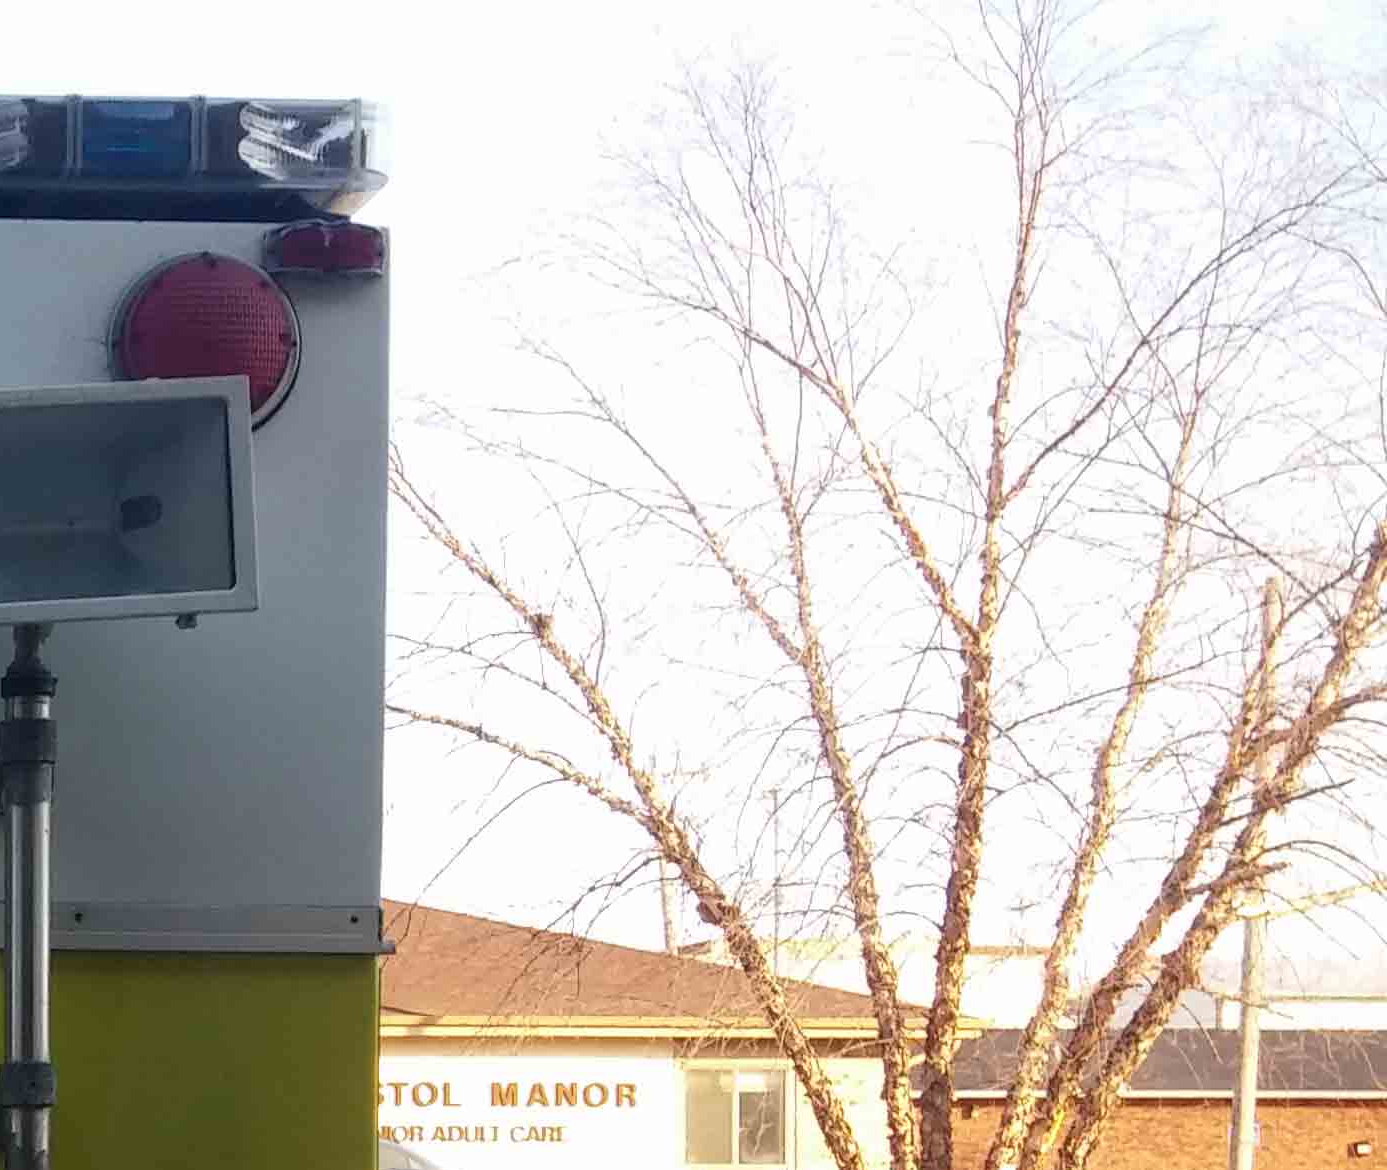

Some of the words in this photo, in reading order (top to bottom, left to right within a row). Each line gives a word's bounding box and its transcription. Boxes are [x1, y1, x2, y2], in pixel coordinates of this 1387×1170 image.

[490, 1082, 637, 1107] MANOR
[431, 1125, 499, 1142] ADULT
[510, 1125, 566, 1142] CARE
